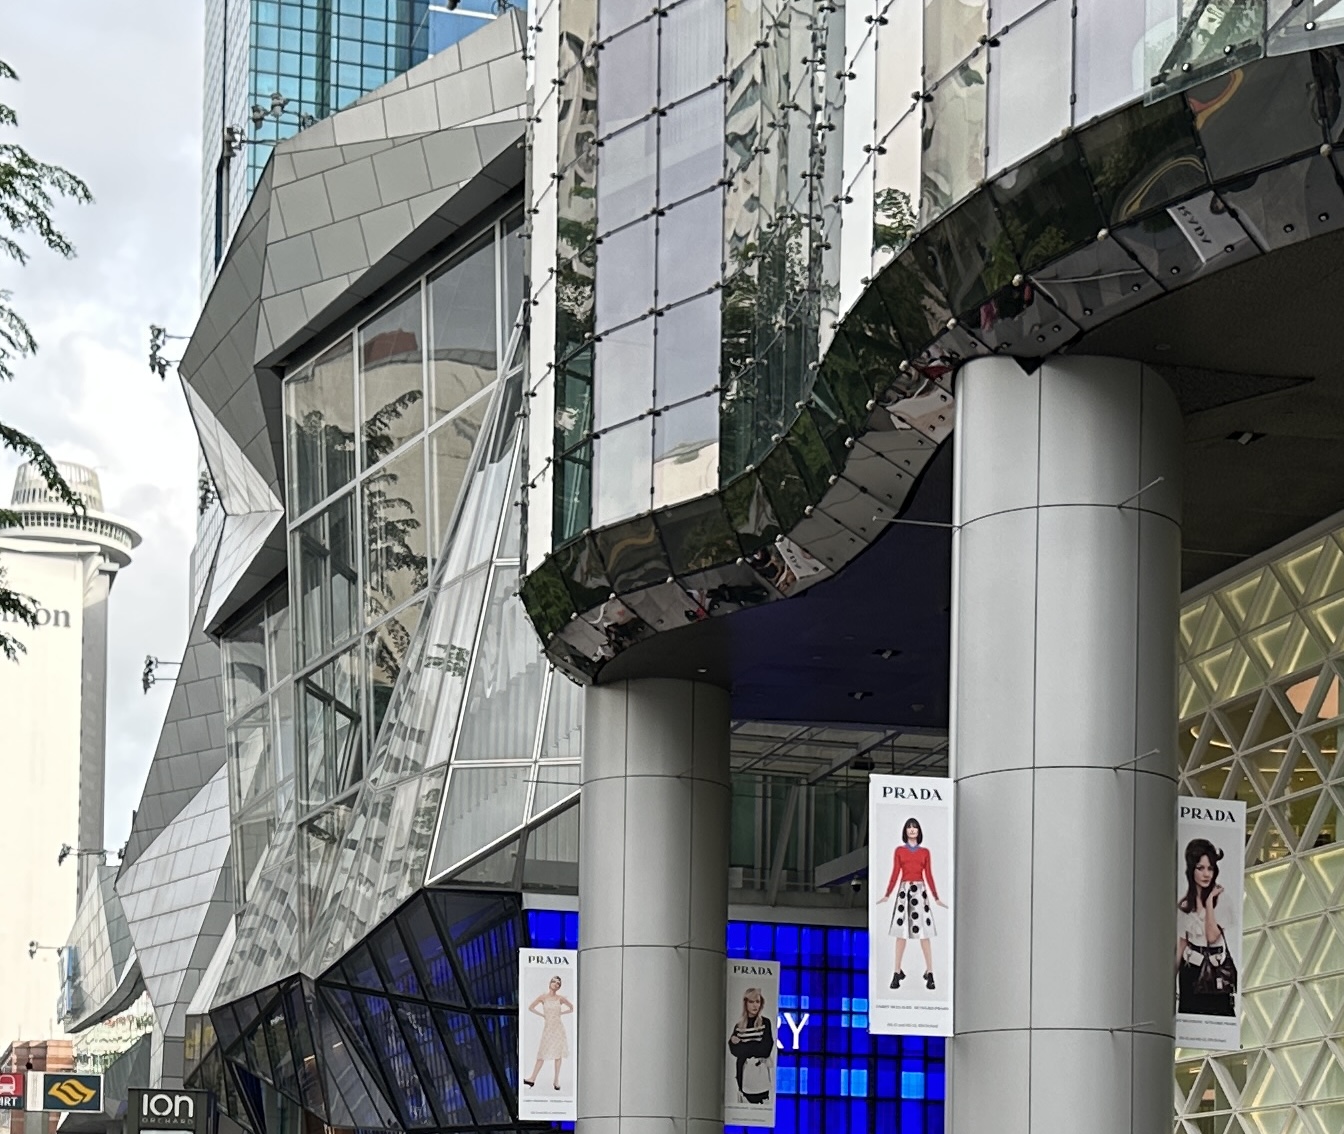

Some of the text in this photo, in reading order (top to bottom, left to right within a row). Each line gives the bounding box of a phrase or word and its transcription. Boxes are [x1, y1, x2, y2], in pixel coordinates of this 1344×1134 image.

[882, 786, 942, 801] PRADA
[1180, 806, 1236, 822] PRADA
[528, 955, 569, 965] PRADA
[733, 965, 773, 975] PRADA
[141, 1117, 194, 1125] ORCHARD
